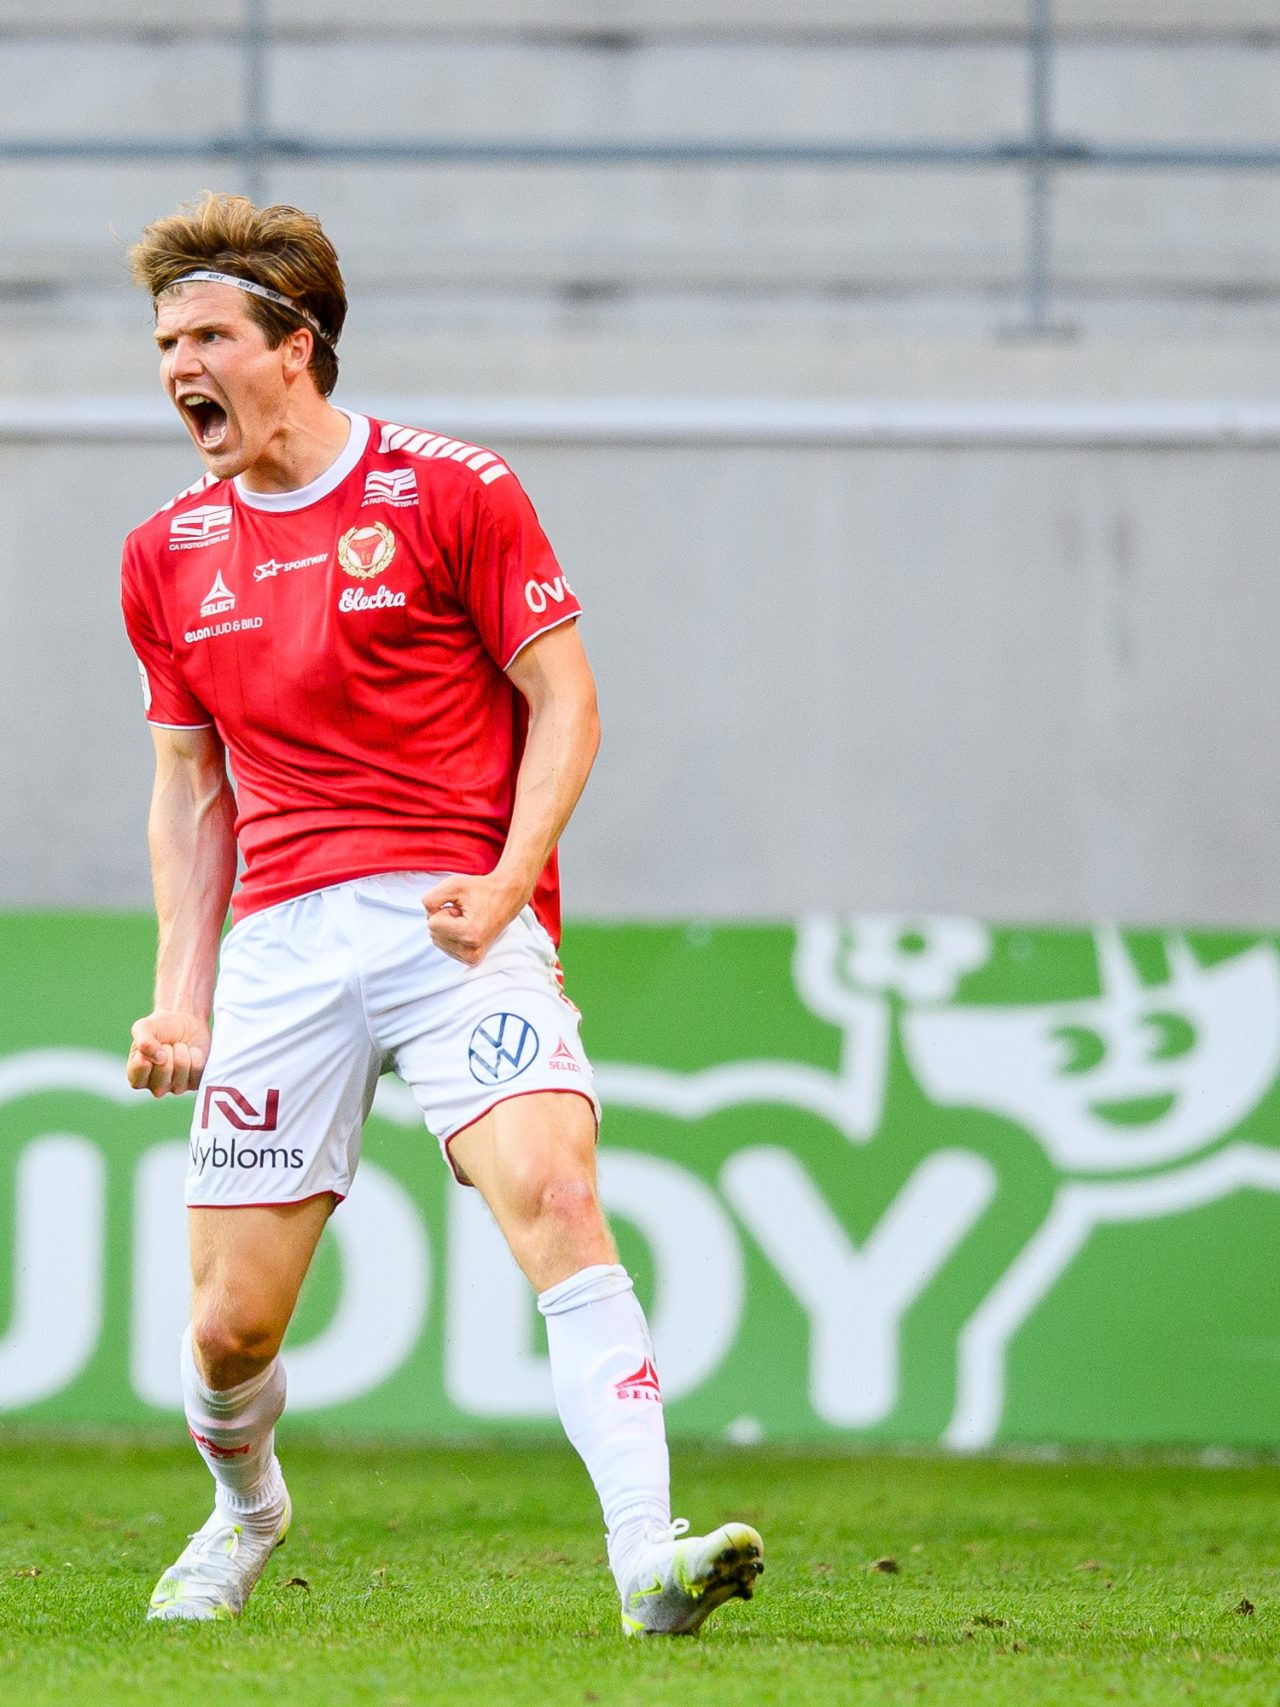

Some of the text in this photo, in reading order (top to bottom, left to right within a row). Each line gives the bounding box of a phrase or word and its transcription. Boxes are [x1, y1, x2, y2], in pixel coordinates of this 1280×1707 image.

[207, 273, 225, 281] NIKE
[238, 280, 256, 291] NIKE
[282, 552, 329, 572] SPORTWAY
[199, 598, 237, 619] SELECT
[338, 584, 407, 613] Electra
[232, 620, 241, 632] &
[241, 616, 264, 631] BILD
